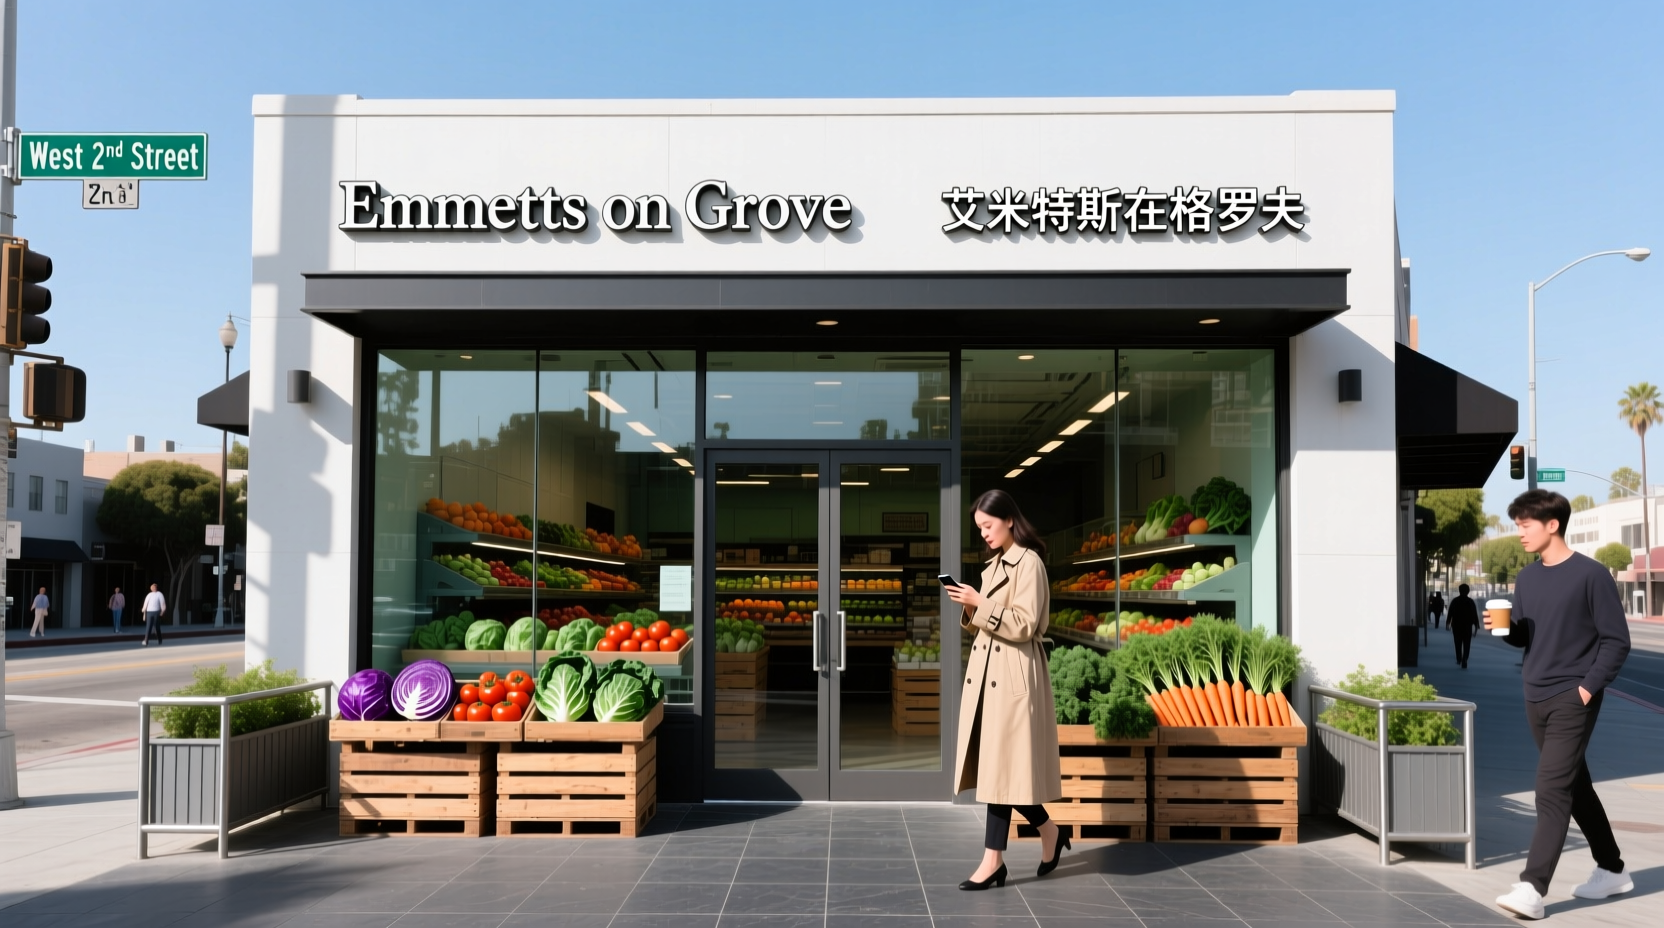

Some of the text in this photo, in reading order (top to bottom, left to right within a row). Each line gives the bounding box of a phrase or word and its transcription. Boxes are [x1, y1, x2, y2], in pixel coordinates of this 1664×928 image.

[29, 140, 199, 170] West 2nd Street
[338, 179, 852, 232] Emmetts on Grove
[941, 185, 1305, 234] 艾米特斯在格罗夫
